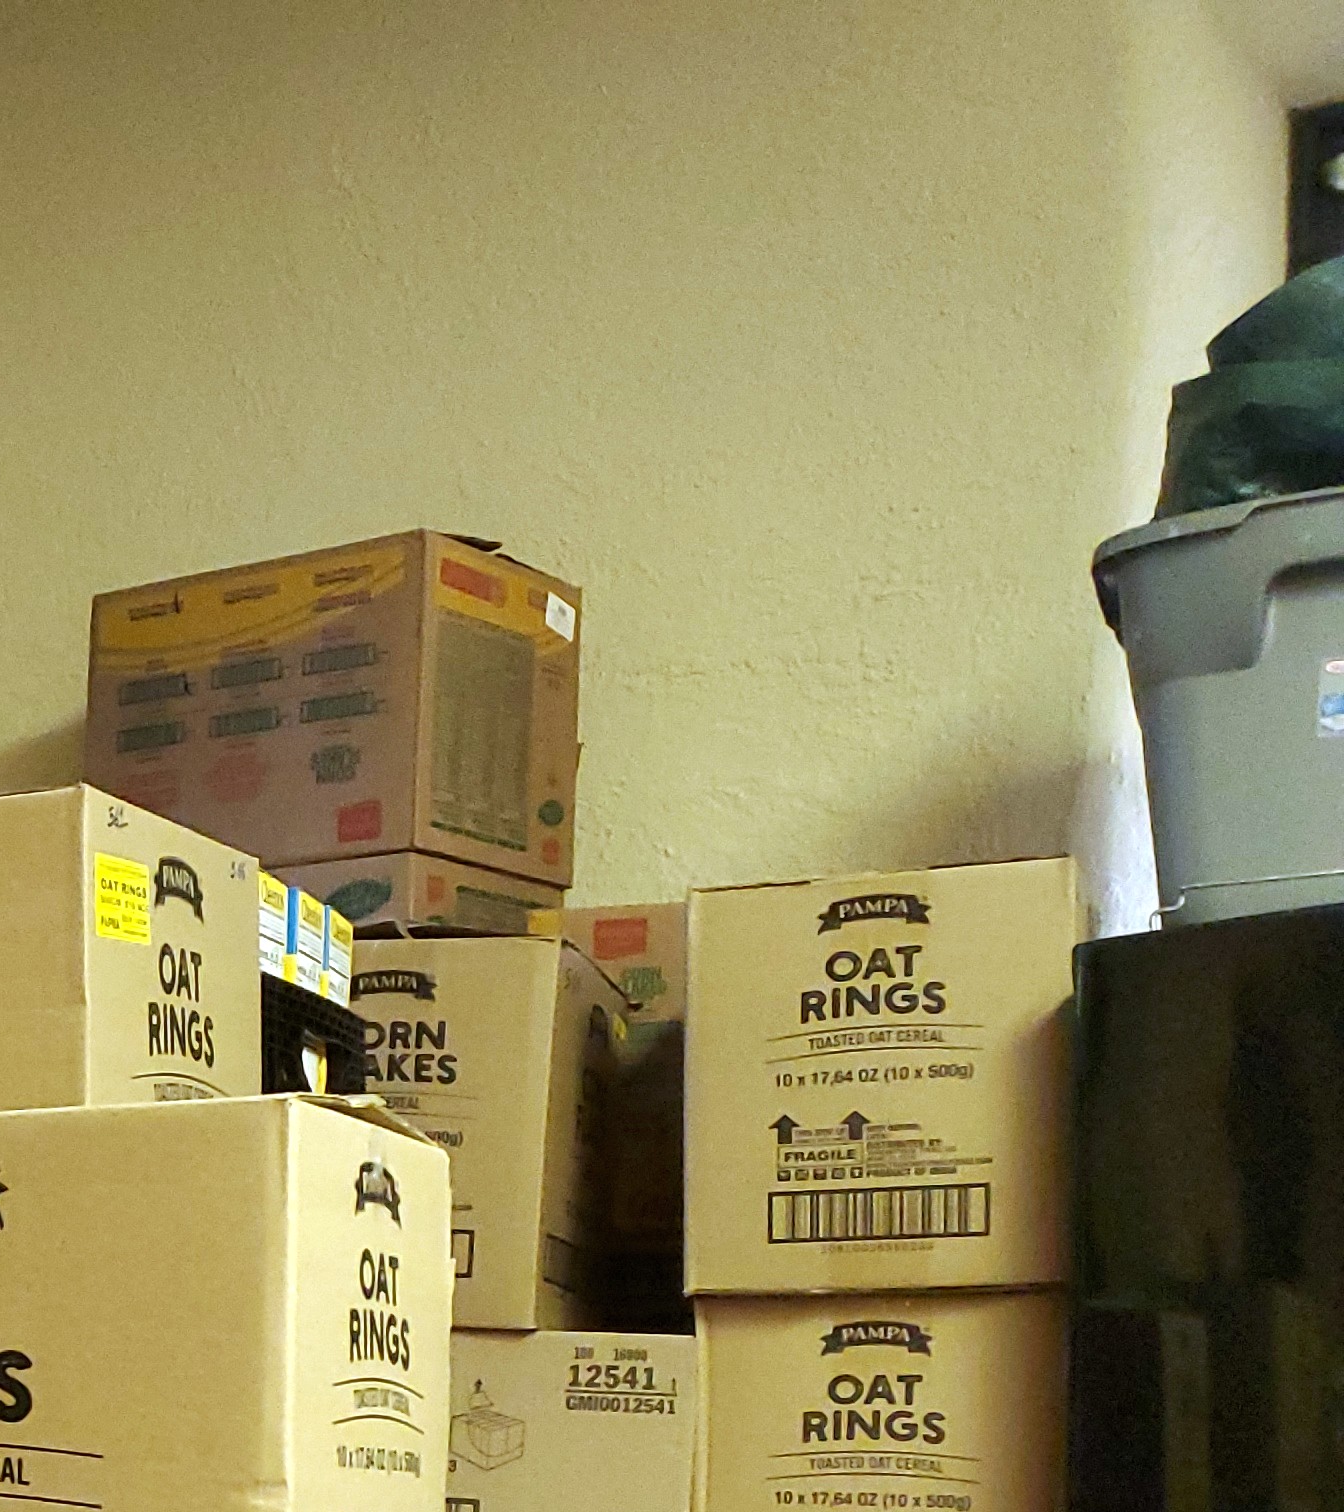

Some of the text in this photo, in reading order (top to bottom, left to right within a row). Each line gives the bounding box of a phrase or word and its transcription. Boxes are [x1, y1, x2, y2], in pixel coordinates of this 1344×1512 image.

[101, 878, 146, 898] OAT RINGS
[162, 865, 195, 898] PAMPA
[839, 898, 909, 918] PAMPA
[158, 944, 202, 1004] OAT
[825, 945, 922, 982] OAT
[359, 975, 417, 989] PAMPA
[801, 982, 946, 1024] RINGS
[148, 1002, 215, 1069] RINGS
[808, 1030, 945, 1050] TOASTED OAT CEREAL
[784, 1149, 856, 1162] FRAGILE
[359, 1248, 398, 1306] OAT
[349, 1308, 410, 1371] RINGS
[841, 1326, 910, 1343] PAMPA
[569, 1364, 655, 1390] 12541
[827, 1374, 923, 1405] OAT
[566, 1395, 676, 1415] GMI0012541
[802, 1410, 946, 1444] RINGS
